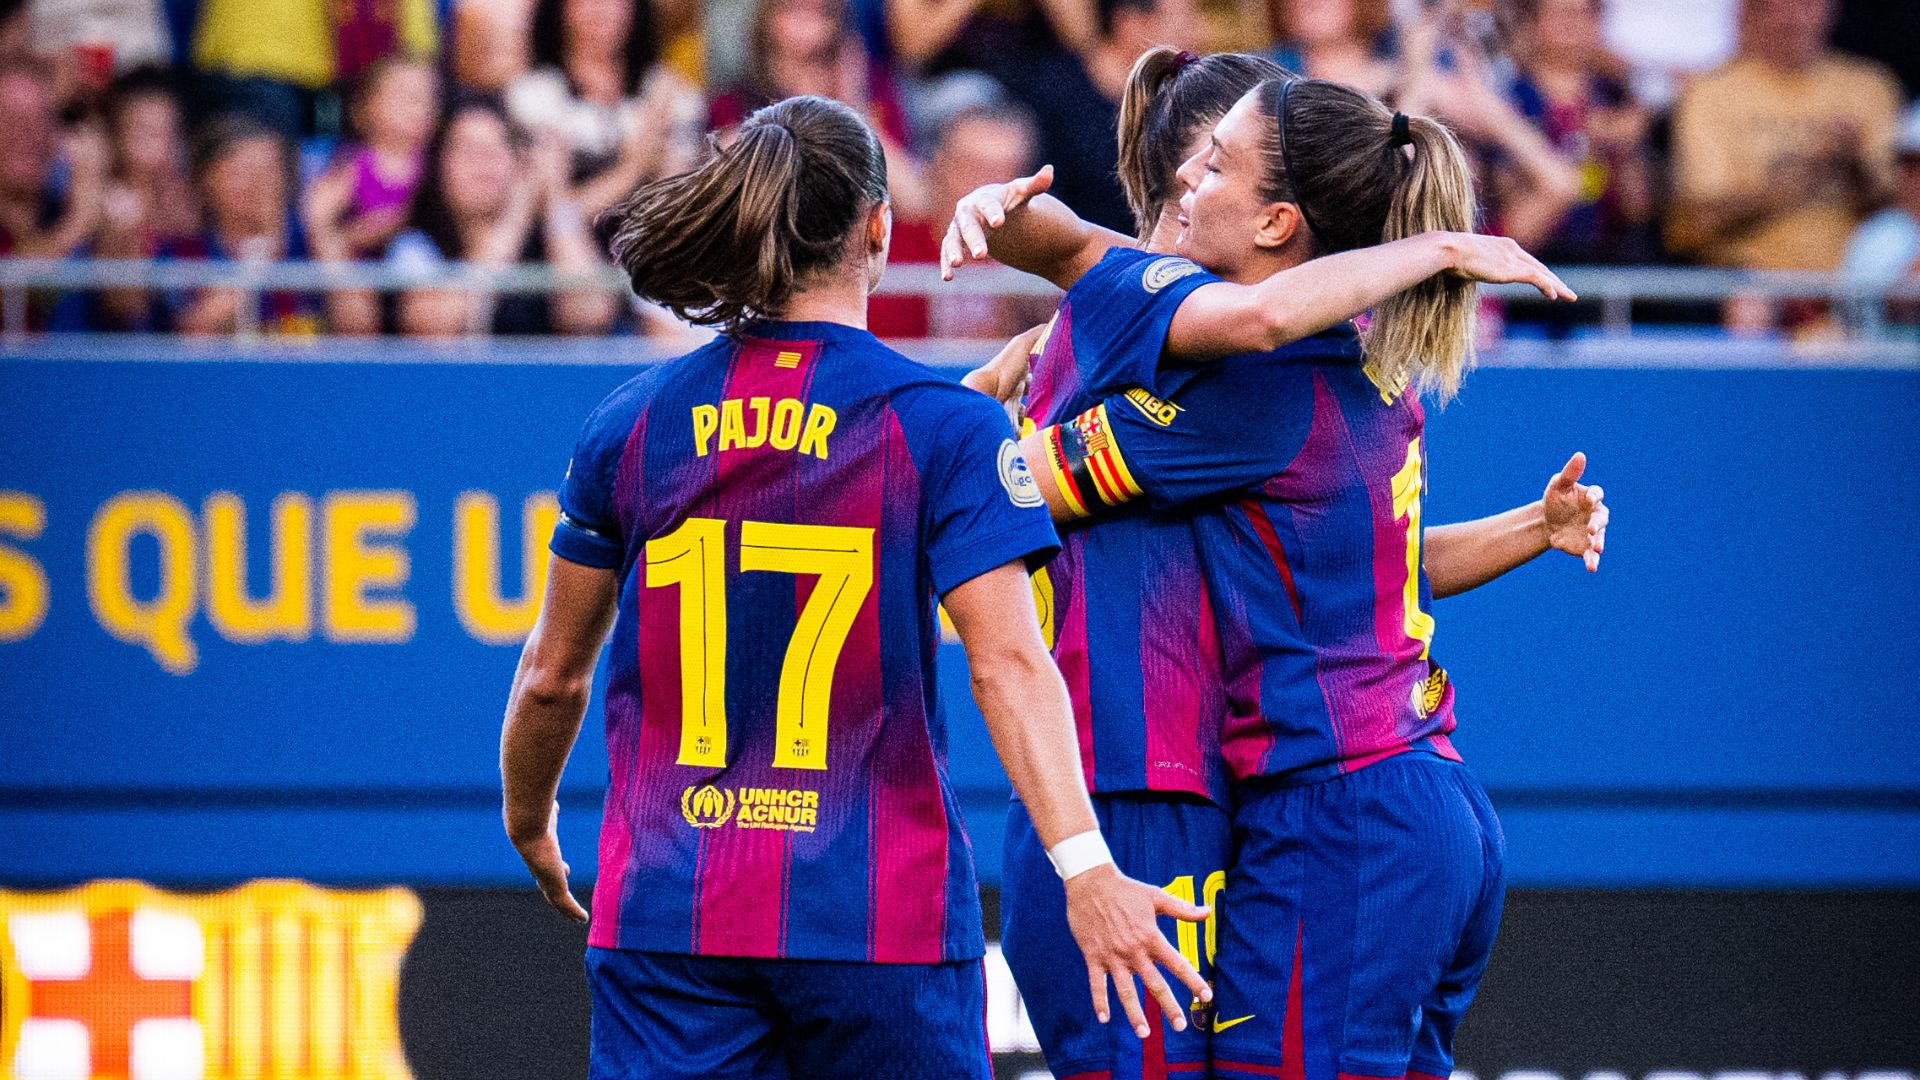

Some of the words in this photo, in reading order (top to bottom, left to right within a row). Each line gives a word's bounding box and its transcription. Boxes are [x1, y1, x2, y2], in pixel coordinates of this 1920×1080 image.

[691, 396, 839, 460] PAJOR
[89, 492, 415, 673] QUE
[645, 517, 875, 769] 17
[736, 805, 817, 825] ACNUR
[738, 787, 819, 808] UNHCR
